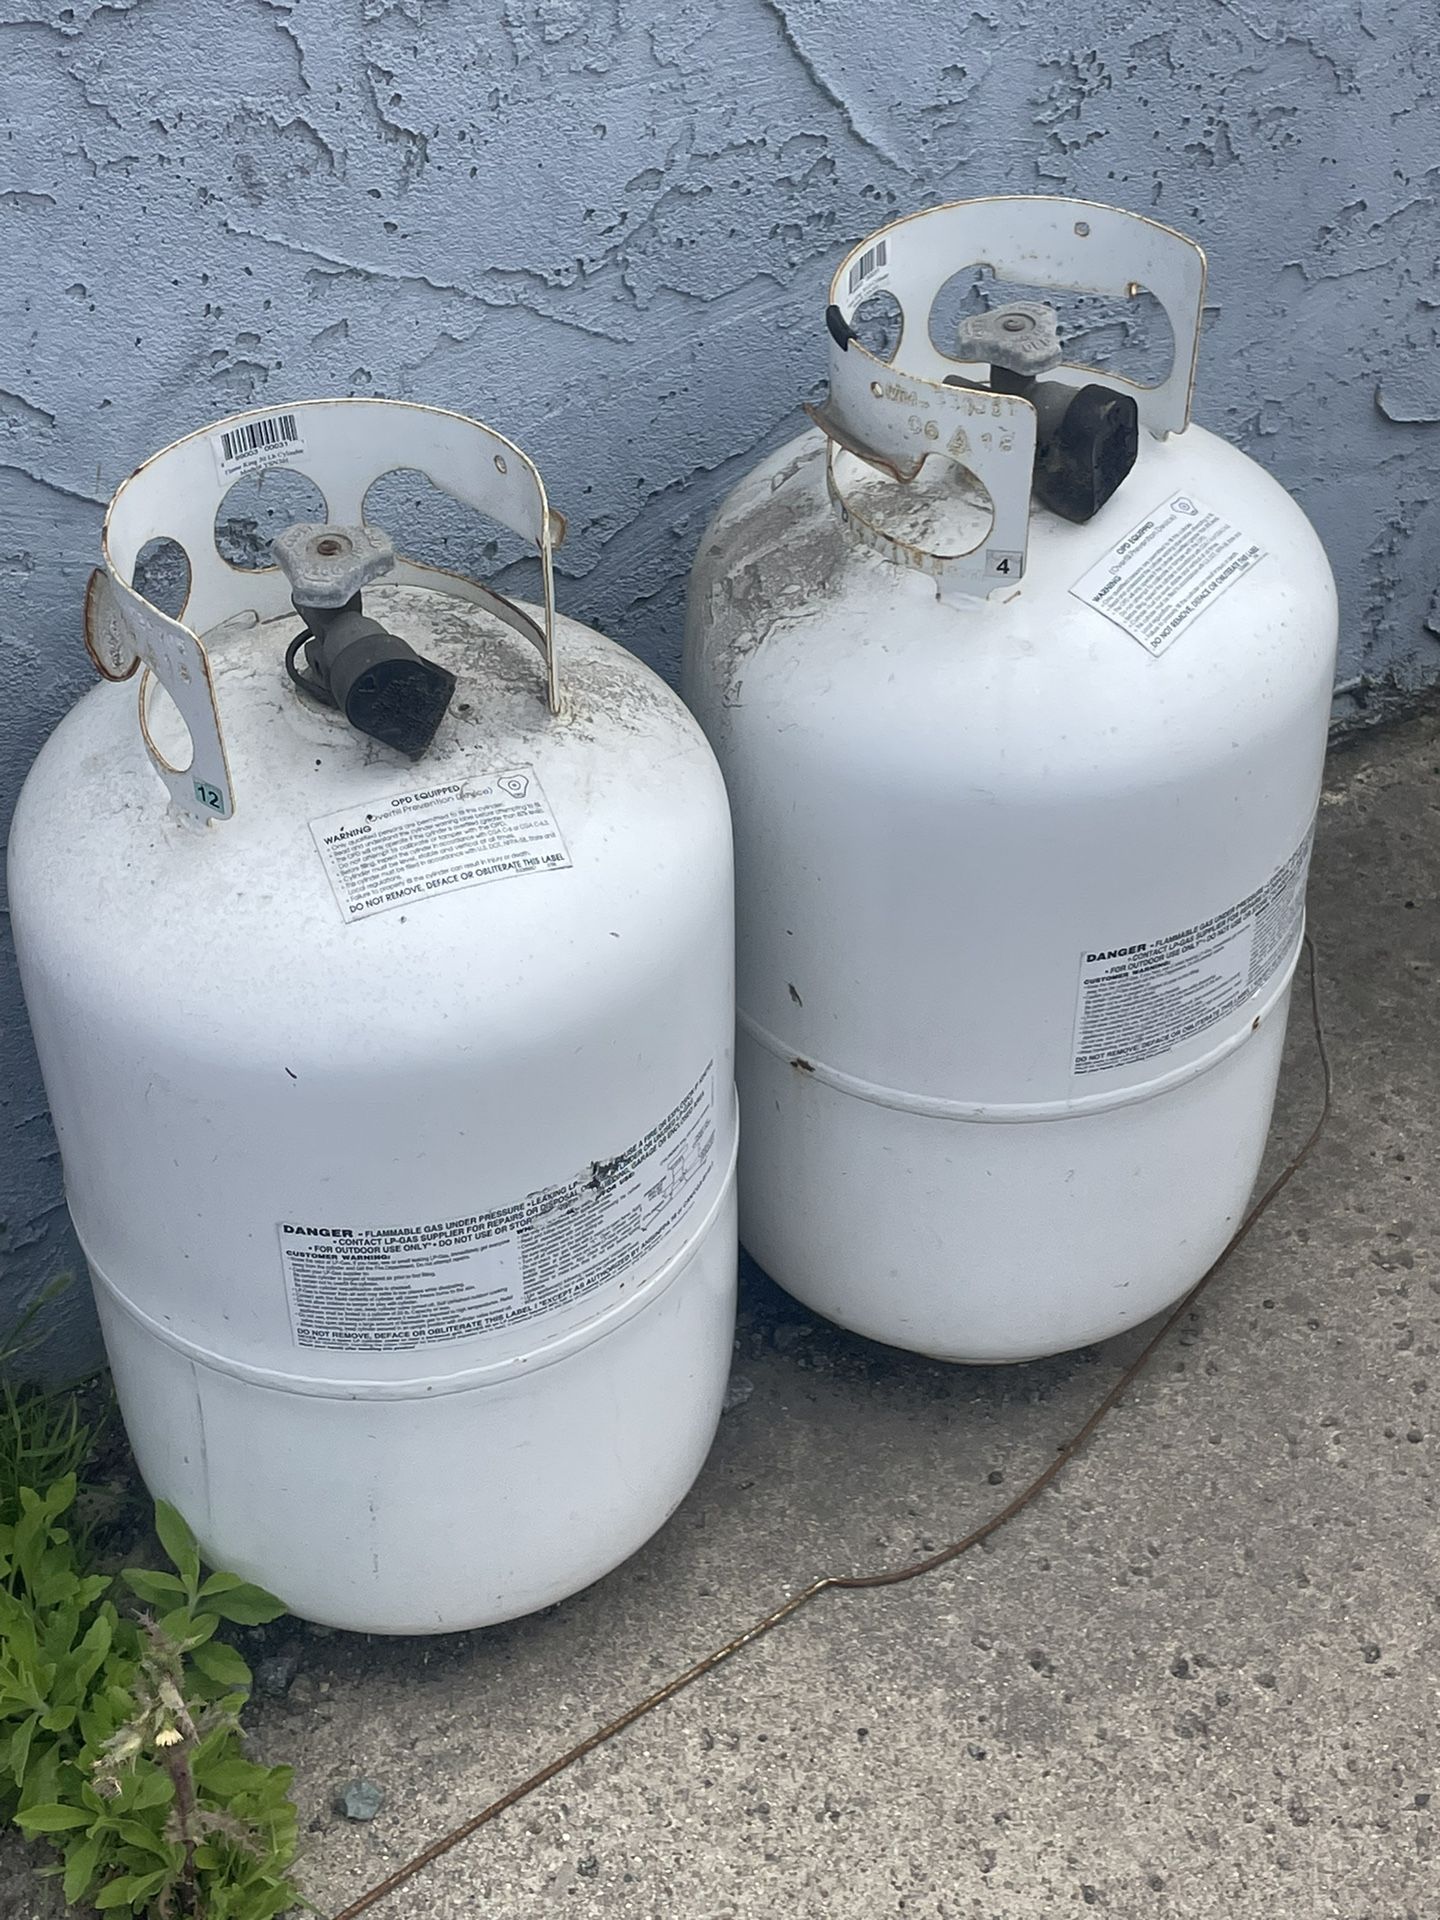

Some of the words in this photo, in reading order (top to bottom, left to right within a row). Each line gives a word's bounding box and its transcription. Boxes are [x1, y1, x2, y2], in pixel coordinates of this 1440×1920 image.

[996, 558, 1010, 574] 4
[198, 786, 220, 808] 12
[391, 795, 412, 807] OPD
[414, 785, 460, 801] EQUIPPED
[403, 796, 454, 813] Prevention
[323, 825, 372, 845] WARNING
[349, 902, 364, 914] DO
[365, 895, 384, 908] NOT
[385, 884, 426, 902] REMOVE,
[425, 874, 458, 890] DEFACE
[460, 871, 474, 880] OR
[475, 861, 522, 877] OBLITERATE
[522, 856, 541, 867] THIS
[541, 853, 565, 864] LABEL
[1086, 943, 1147, 963] DANGER
[1155, 924, 1199, 947] FLAMMABLE
[1199, 920, 1213, 930] GAS
[1132, 945, 1168, 961] CONTACT
[1169, 937, 1194, 951] LP-GAS
[1195, 920, 1226, 940] SUPPLIER
[1127, 956, 1165, 970] OUTDOOR
[1166, 949, 1180, 959] USE
[1083, 972, 1129, 985] CUSTOMER
[1088, 1051, 1105, 1060] NOT
[283, 1224, 353, 1237] DANGER
[365, 1226, 422, 1238] FLAMMABLE
[424, 1223, 443, 1233] GAS
[445, 1216, 477, 1230] UNDER
[479, 1203, 525, 1222] PRESSURE
[531, 1186, 567, 1206] LEAKING
[339, 1238, 382, 1247] CONTACT
[385, 1235, 418, 1246] LP-GAS
[420, 1229, 465, 1242] SUPPLIER
[466, 1223, 485, 1234] FOR
[487, 1211, 525, 1232] REPAIRS
[526, 1206, 538, 1217] OR
[539, 1189, 578, 1211] DISPOSAL
[335, 1246, 381, 1254] OUTDOOR
[382, 1245, 402, 1253] USE
[439, 1239, 452, 1247] DO
[454, 1234, 472, 1244] NOT
[475, 1229, 493, 1240] USE
[494, 1224, 508, 1235] OR
[286, 1250, 338, 1260] CUSTOMER
[297, 1328, 310, 1336] DO
[331, 1331, 372, 1340] REMOVE,
[374, 1330, 411, 1339] DEFACE
[412, 1329, 426, 1338] OR
[427, 1321, 482, 1335] OBLITERATE
[484, 1313, 505, 1325] THIS
[506, 1306, 533, 1320] LABEL
[574, 1281, 586, 1293] AS
